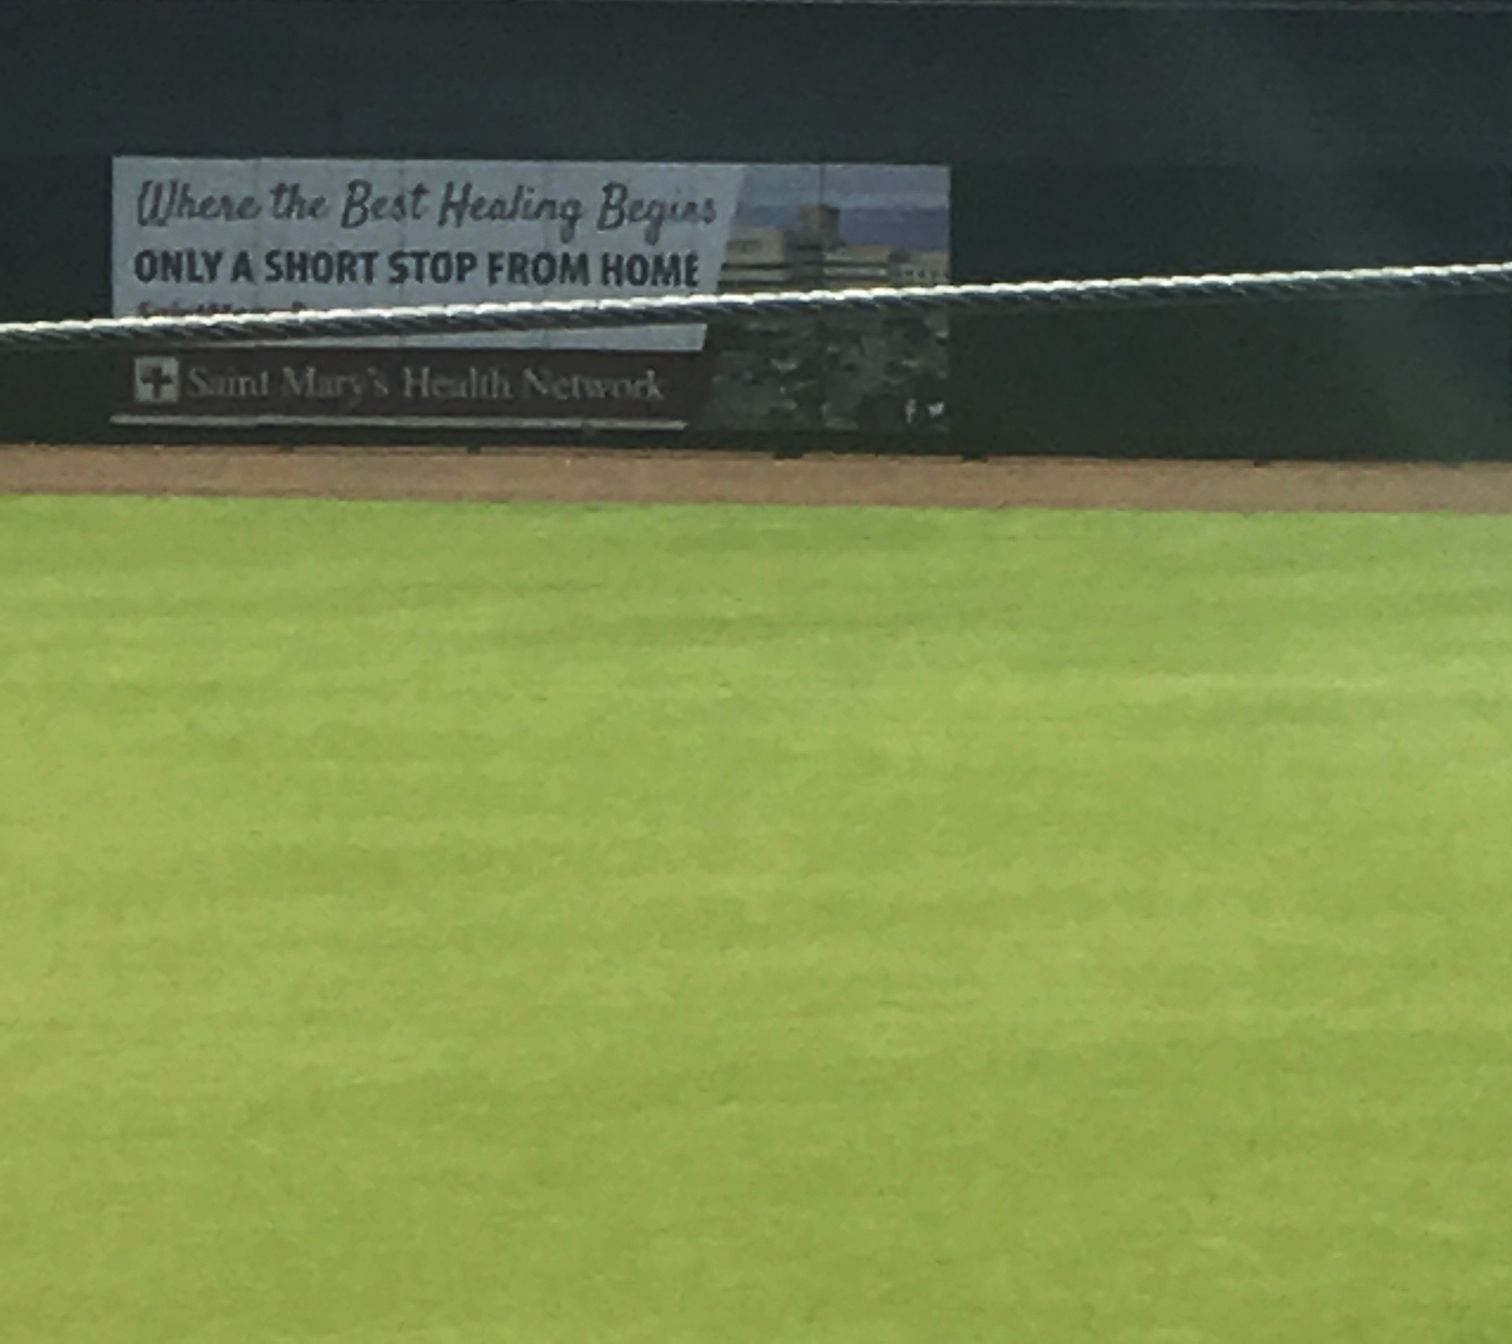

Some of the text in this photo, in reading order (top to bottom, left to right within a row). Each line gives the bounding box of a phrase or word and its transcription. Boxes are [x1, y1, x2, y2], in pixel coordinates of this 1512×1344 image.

[136, 178, 719, 246] Where the Best Healing Begins
[134, 248, 700, 288] ONLY A SHORT STOP FROM HOME
[186, 365, 666, 409] Saint Mary's Health Network
